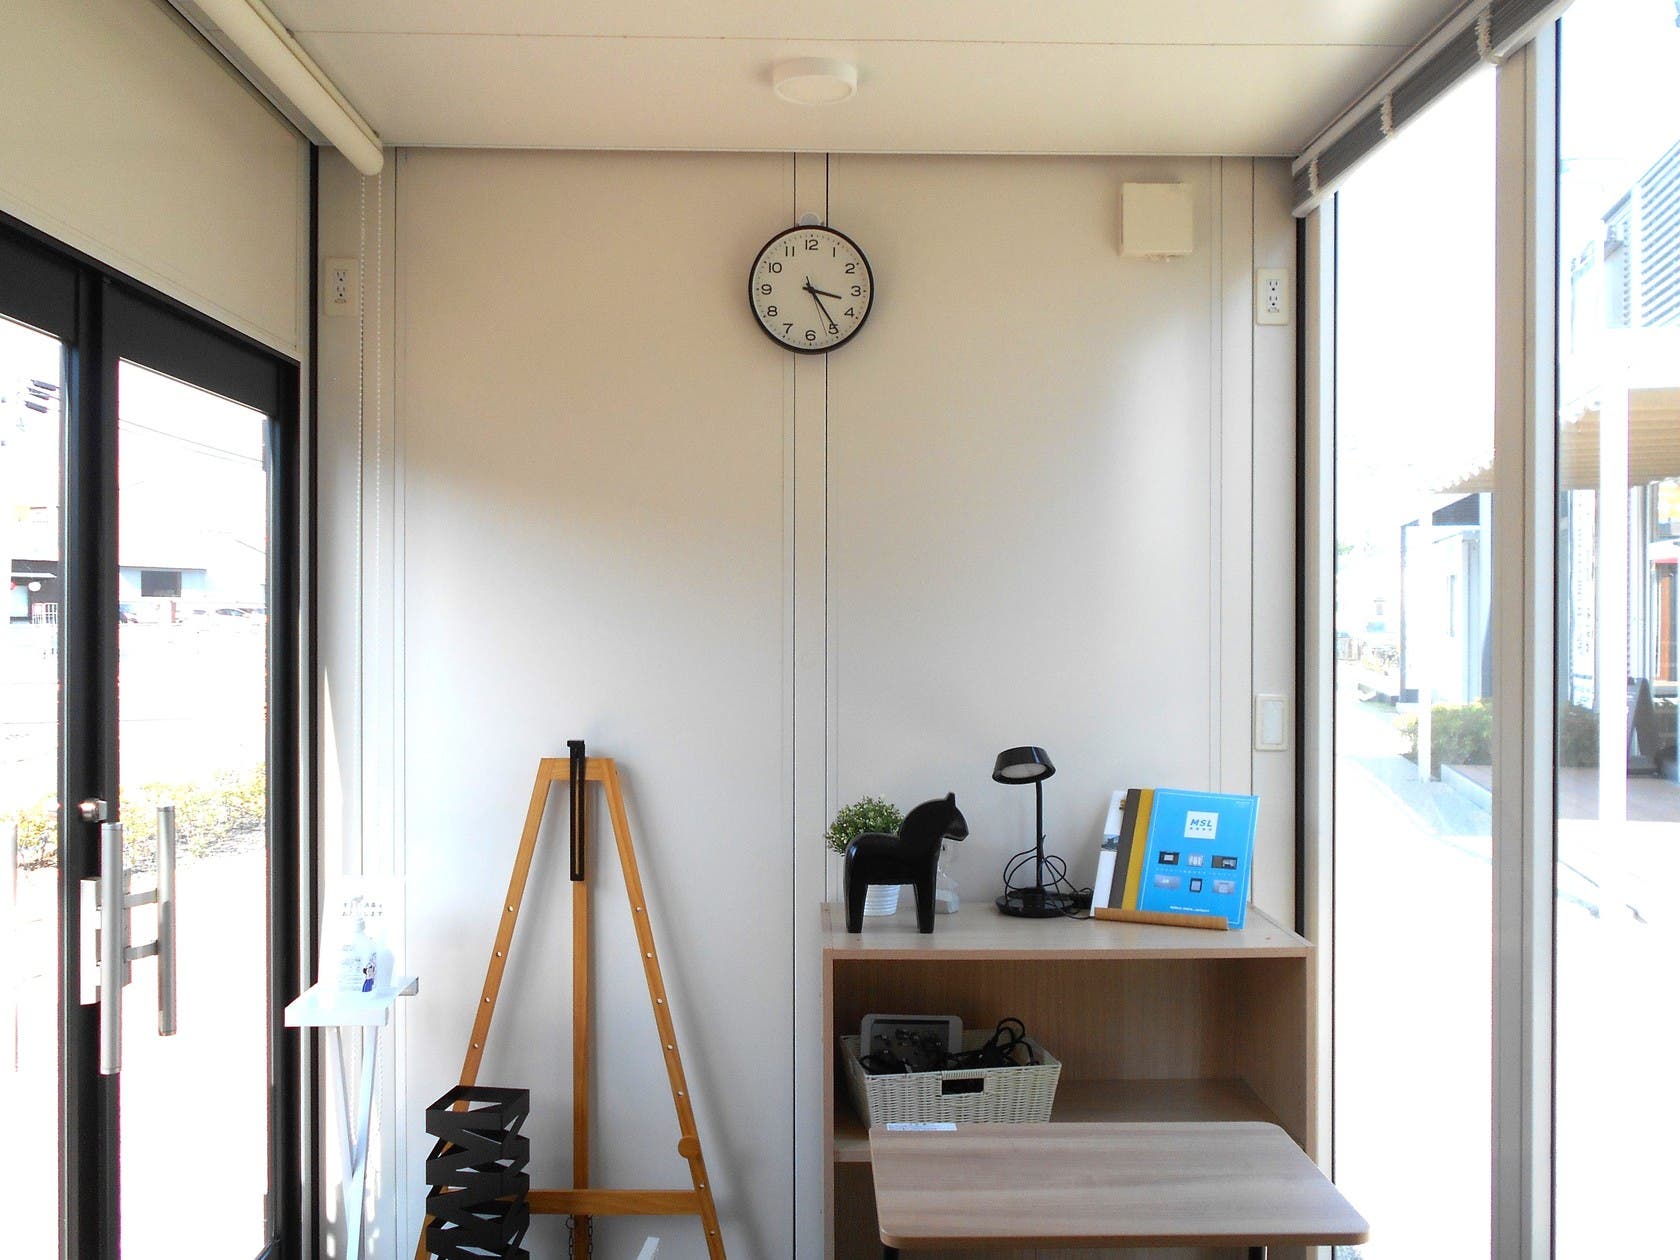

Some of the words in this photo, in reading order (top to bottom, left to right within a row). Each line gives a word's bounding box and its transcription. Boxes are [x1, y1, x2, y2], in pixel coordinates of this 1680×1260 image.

[805, 239, 819, 250] 12
[785, 246, 795, 257] 11
[768, 262, 782, 273] 10
[845, 263, 855, 274] 2
[761, 284, 772, 295] 9
[851, 285, 861, 297] 3
[767, 305, 778, 317] 8
[844, 307, 855, 318] 4
[783, 323, 793, 334] 7
[828, 324, 839, 335] 5
[805, 330, 816, 341] 6
[1190, 818, 1213, 827] MSL
